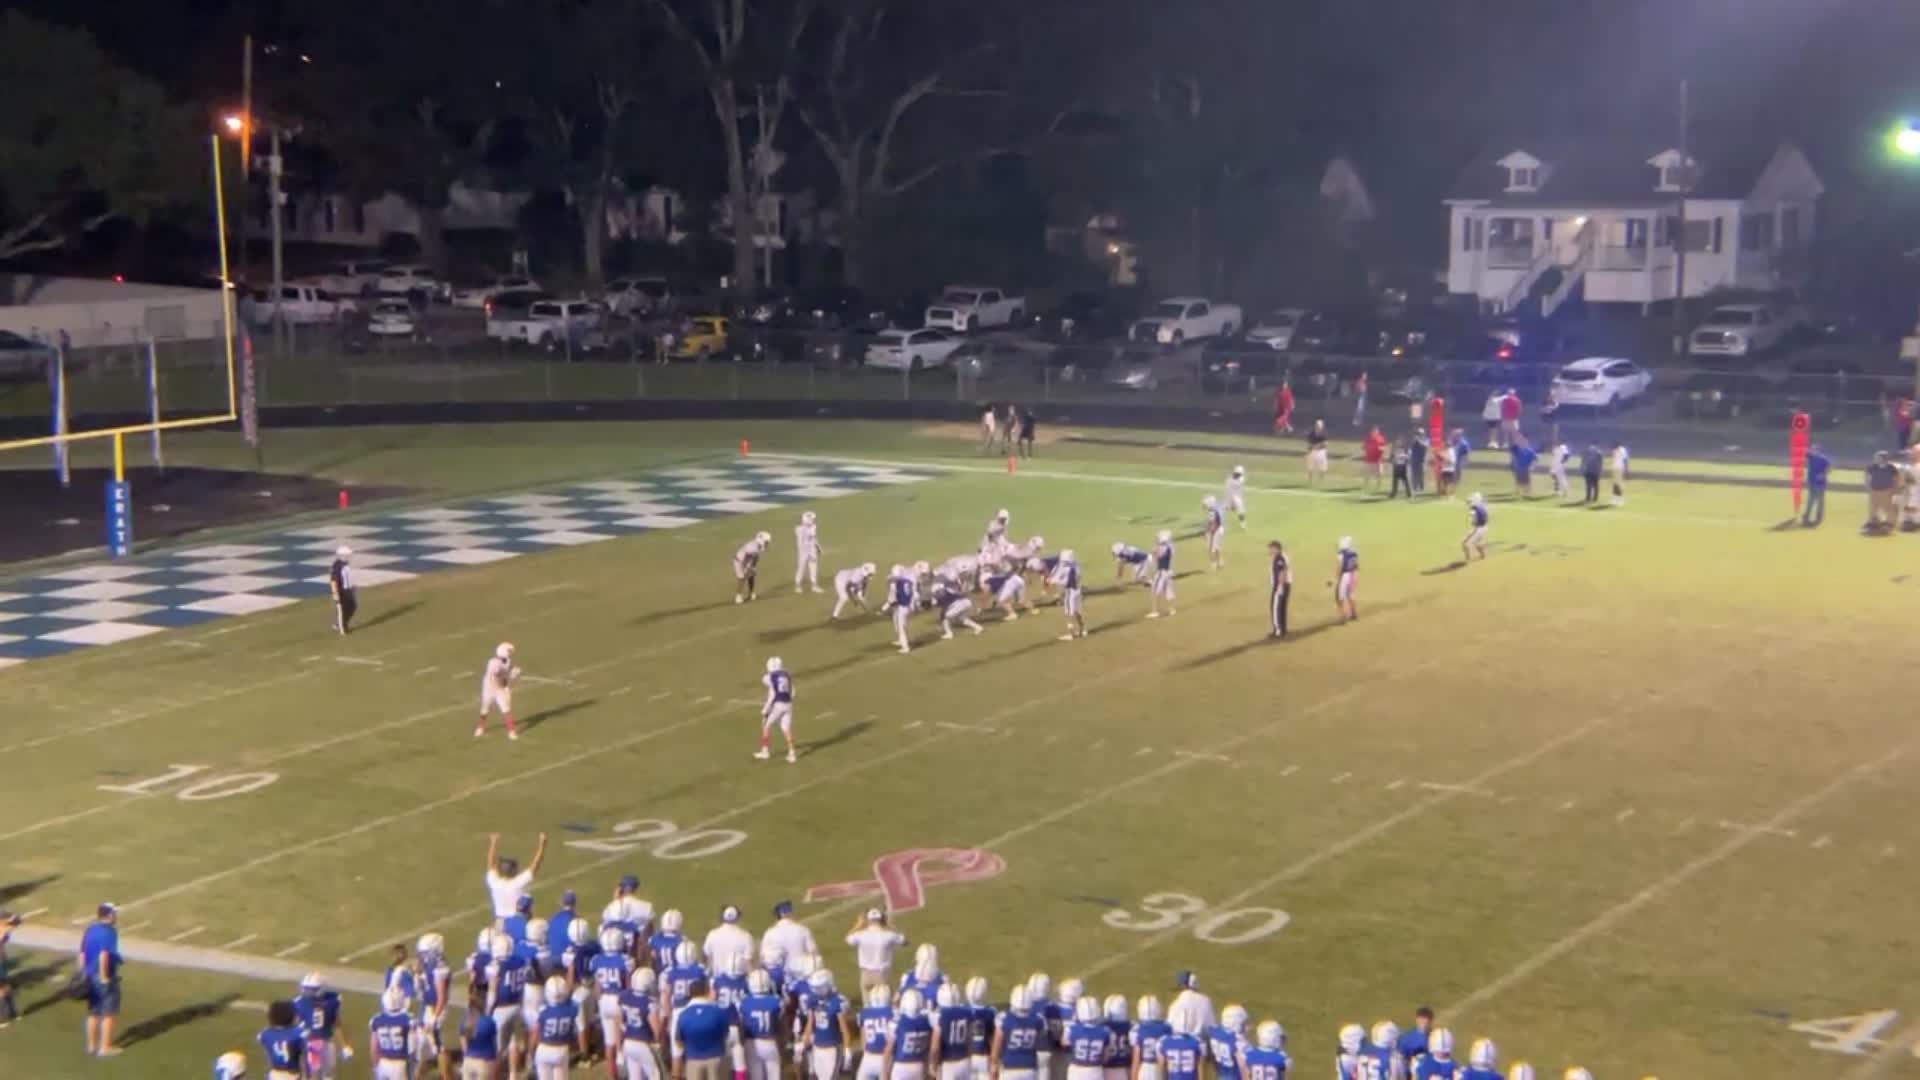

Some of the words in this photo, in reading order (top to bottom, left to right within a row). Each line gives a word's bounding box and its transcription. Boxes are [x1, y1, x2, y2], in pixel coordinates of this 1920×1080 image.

[96, 764, 280, 800] 10
[564, 819, 748, 860] 20
[1102, 892, 1290, 944] 30
[269, 1040, 290, 1065] 4
